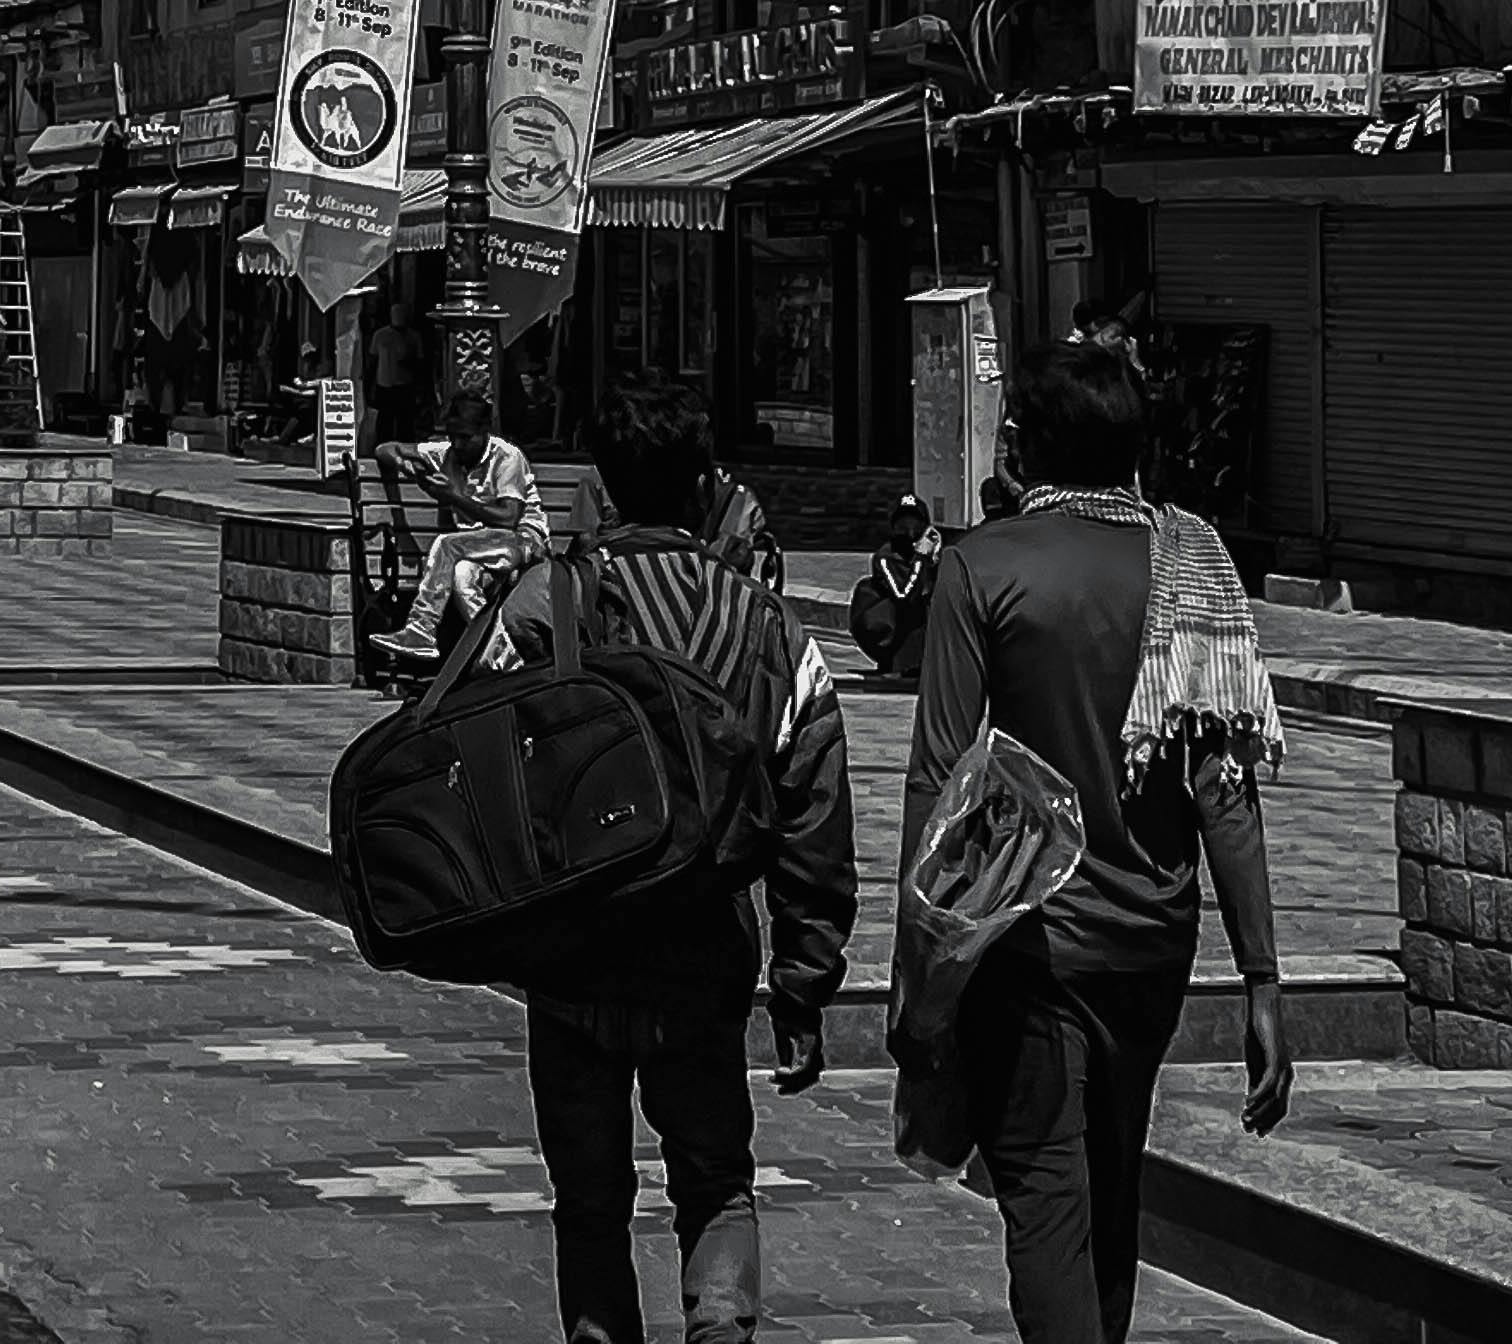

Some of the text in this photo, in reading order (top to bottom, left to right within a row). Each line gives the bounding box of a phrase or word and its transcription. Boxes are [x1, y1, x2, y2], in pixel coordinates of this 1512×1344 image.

[513, 0, 589, 25] MARATHON
[361, 17, 392, 39] Sep
[534, 40, 583, 65] Edition
[1160, 45, 1369, 75] GENERAL MERCHANTS
[552, 62, 580, 83] Sep
[284, 188, 379, 219] The Ultimate
[273, 204, 393, 238] Endurance Race
